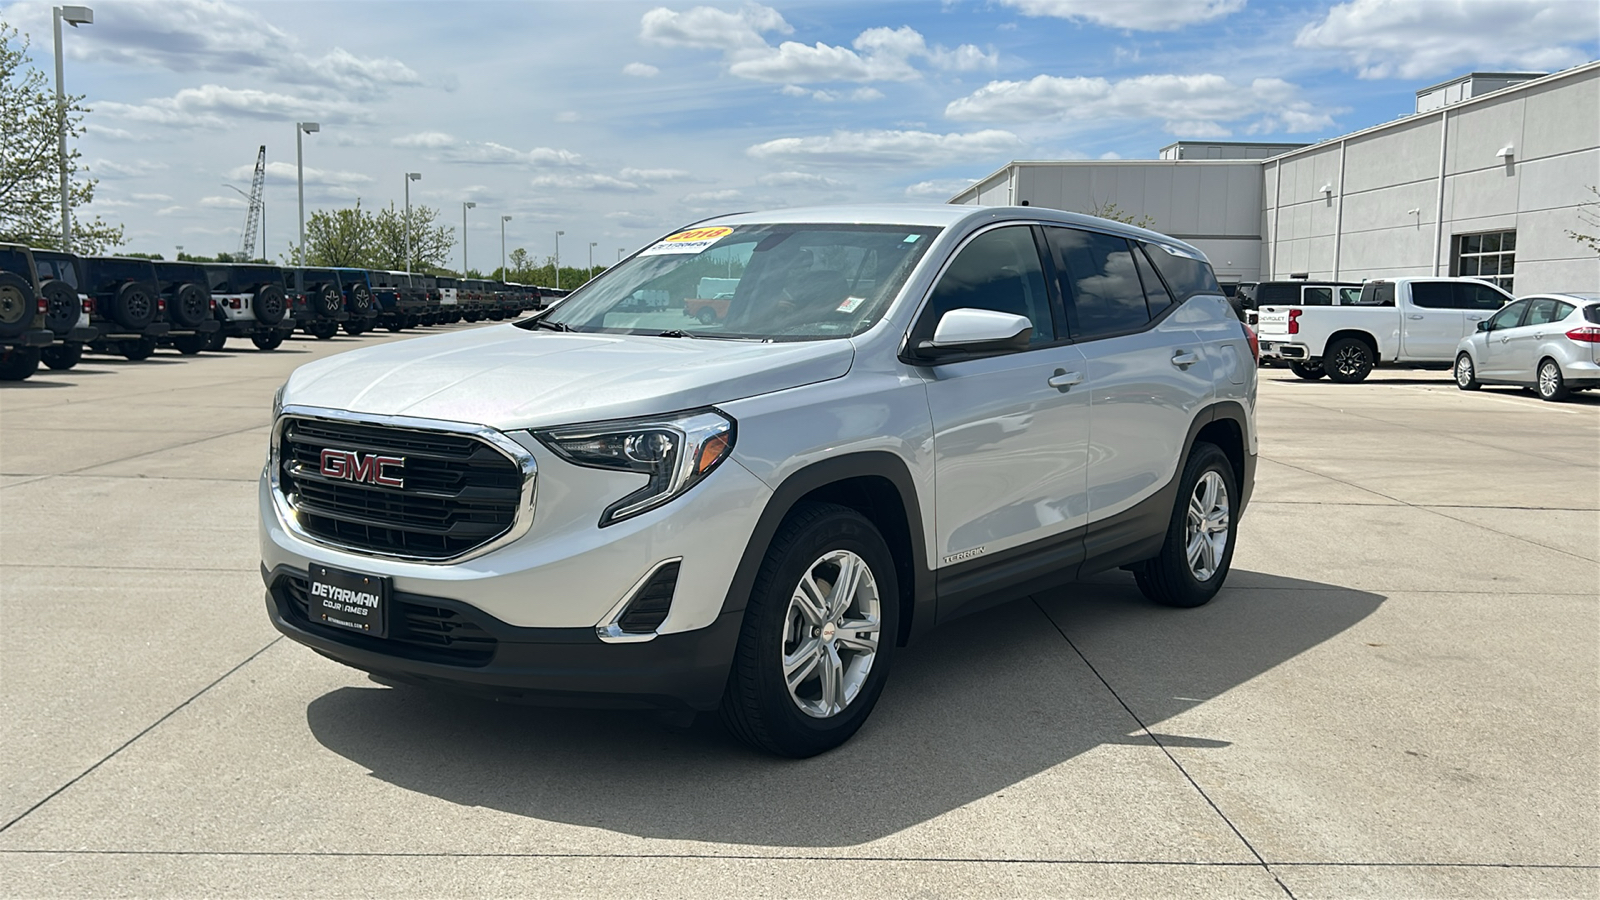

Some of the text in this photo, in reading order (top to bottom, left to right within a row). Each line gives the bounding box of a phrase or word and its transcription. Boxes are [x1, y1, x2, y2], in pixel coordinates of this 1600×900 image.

[669, 228, 728, 240] 2018
[320, 448, 406, 488] GMC
[943, 546, 986, 564] TERRAIN
[311, 581, 379, 609] DEYARMAN
[322, 600, 369, 616] CDJR AMES
